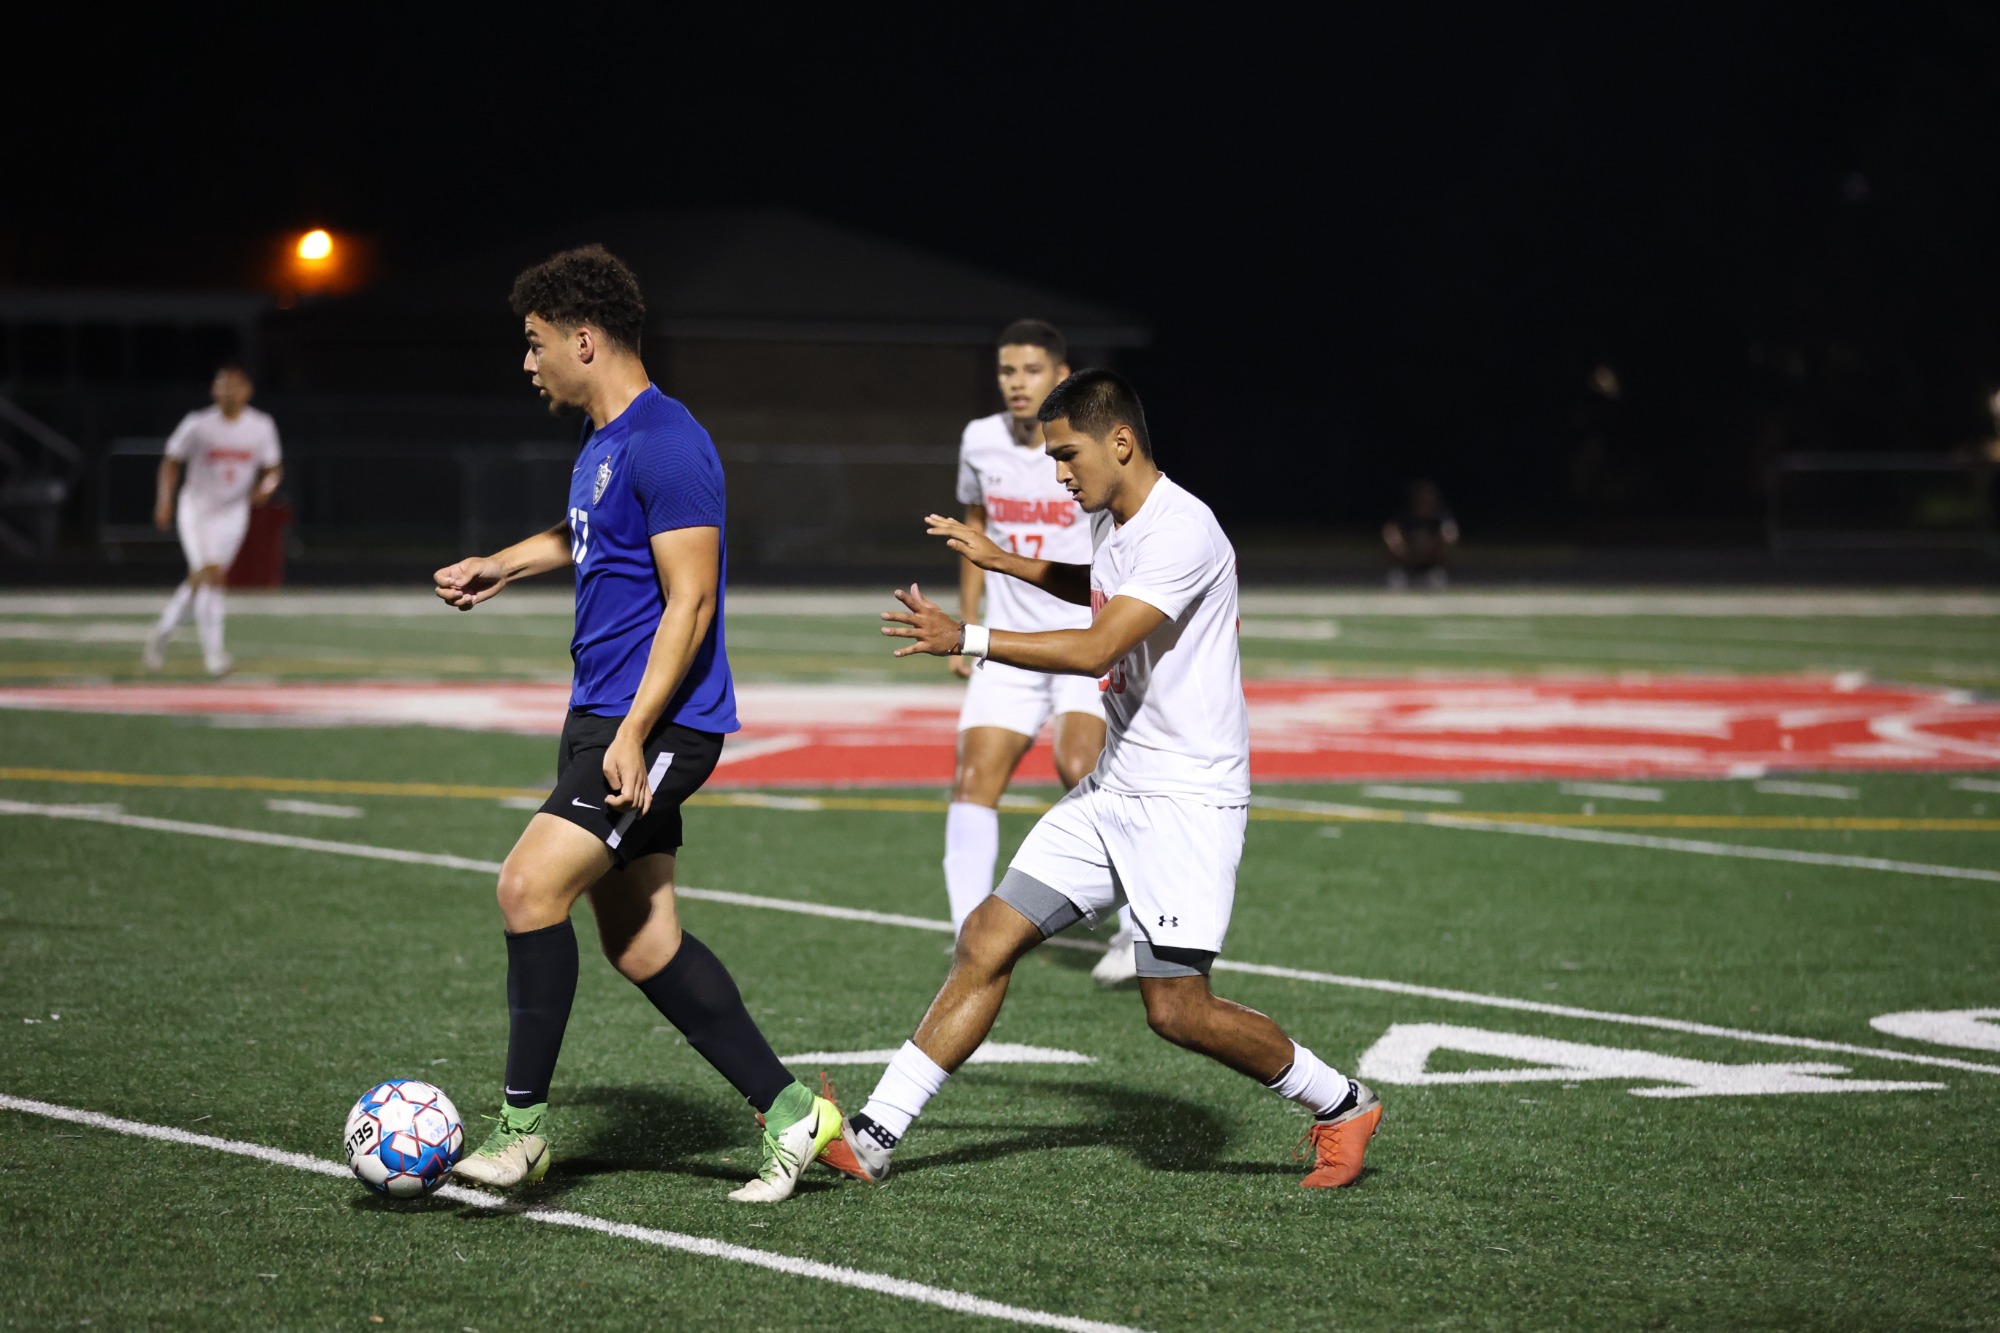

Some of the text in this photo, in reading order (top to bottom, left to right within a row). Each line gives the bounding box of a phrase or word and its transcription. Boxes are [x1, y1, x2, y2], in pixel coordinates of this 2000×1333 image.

[987, 496, 1076, 529] COUGARS
[570, 507, 589, 565] 17
[1009, 533, 1044, 559] 17
